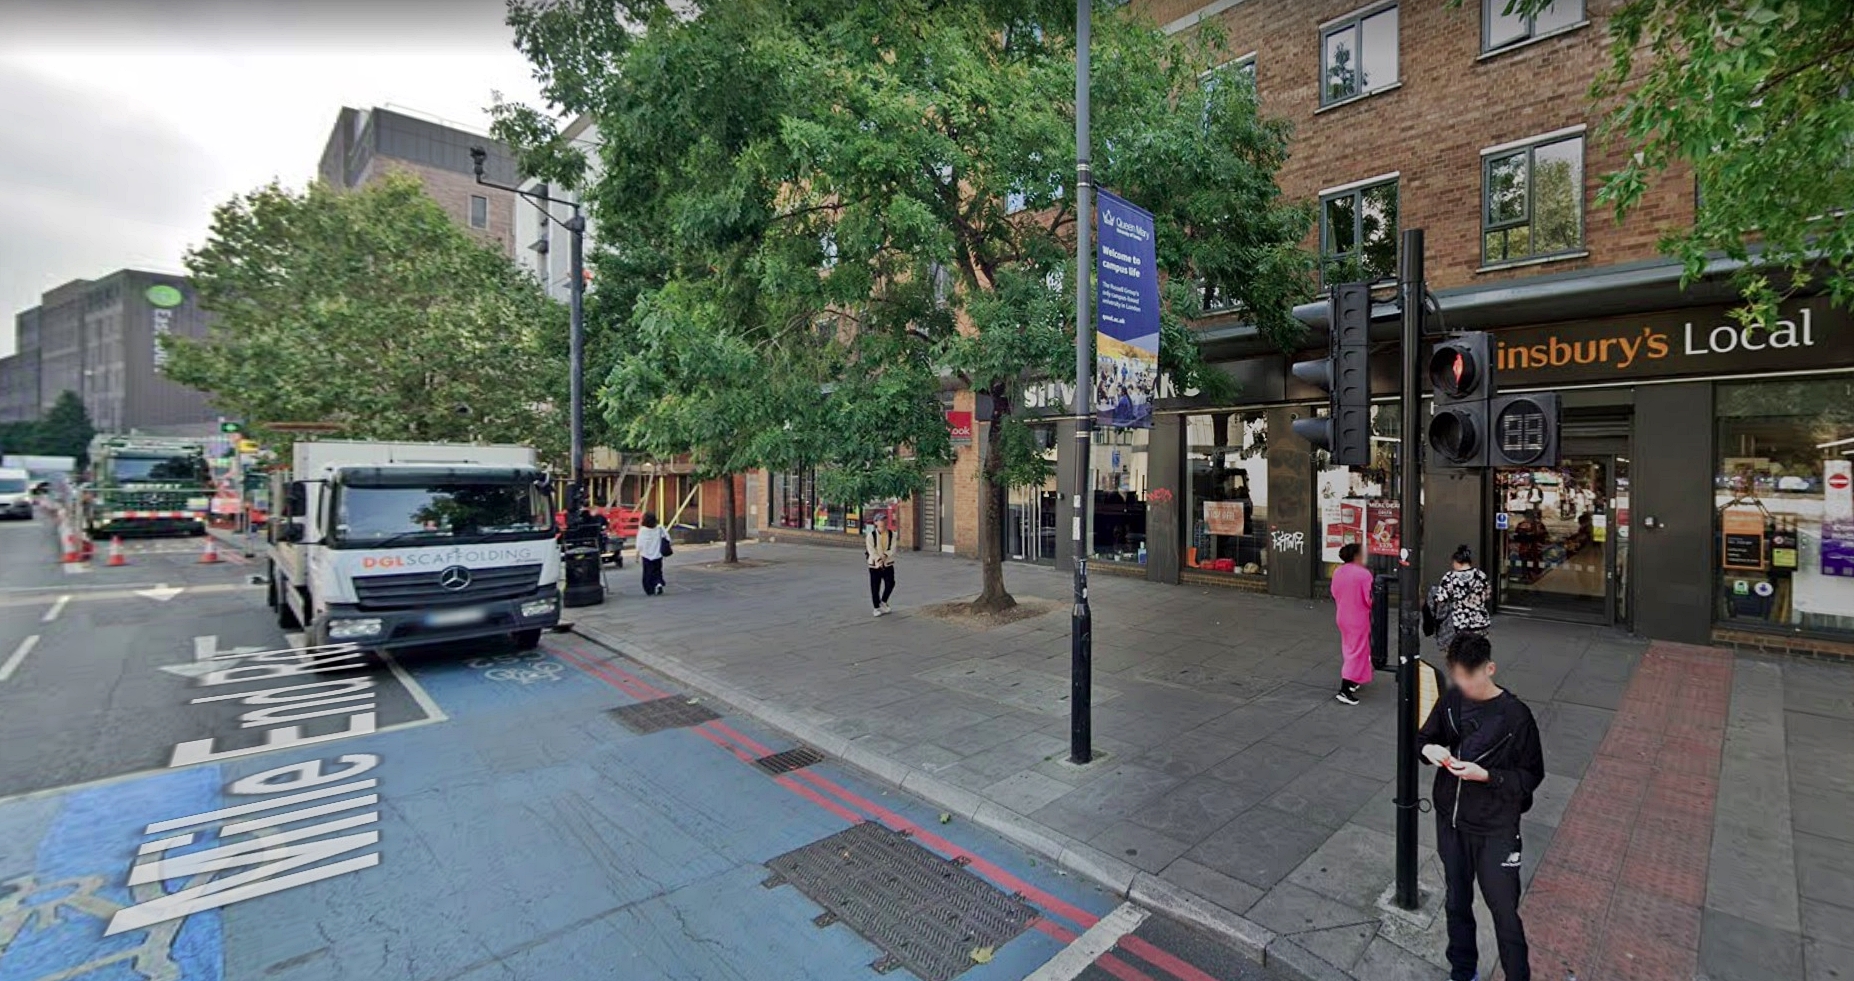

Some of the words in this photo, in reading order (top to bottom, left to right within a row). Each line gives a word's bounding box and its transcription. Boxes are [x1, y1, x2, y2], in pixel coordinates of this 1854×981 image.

[1116, 217, 1136, 232] Queen
[1136, 224, 1149, 241] Mary
[1102, 245, 1132, 263] Welcome
[1132, 255, 1141, 265] to
[1102, 260, 1128, 275] campus
[1128, 266, 1141, 278] life
[1497, 327, 1669, 371] insbury's
[1684, 307, 1815, 356] Local
[362, 556, 405, 569] DGL
[406, 548, 532, 567] SCAFFOLDING
